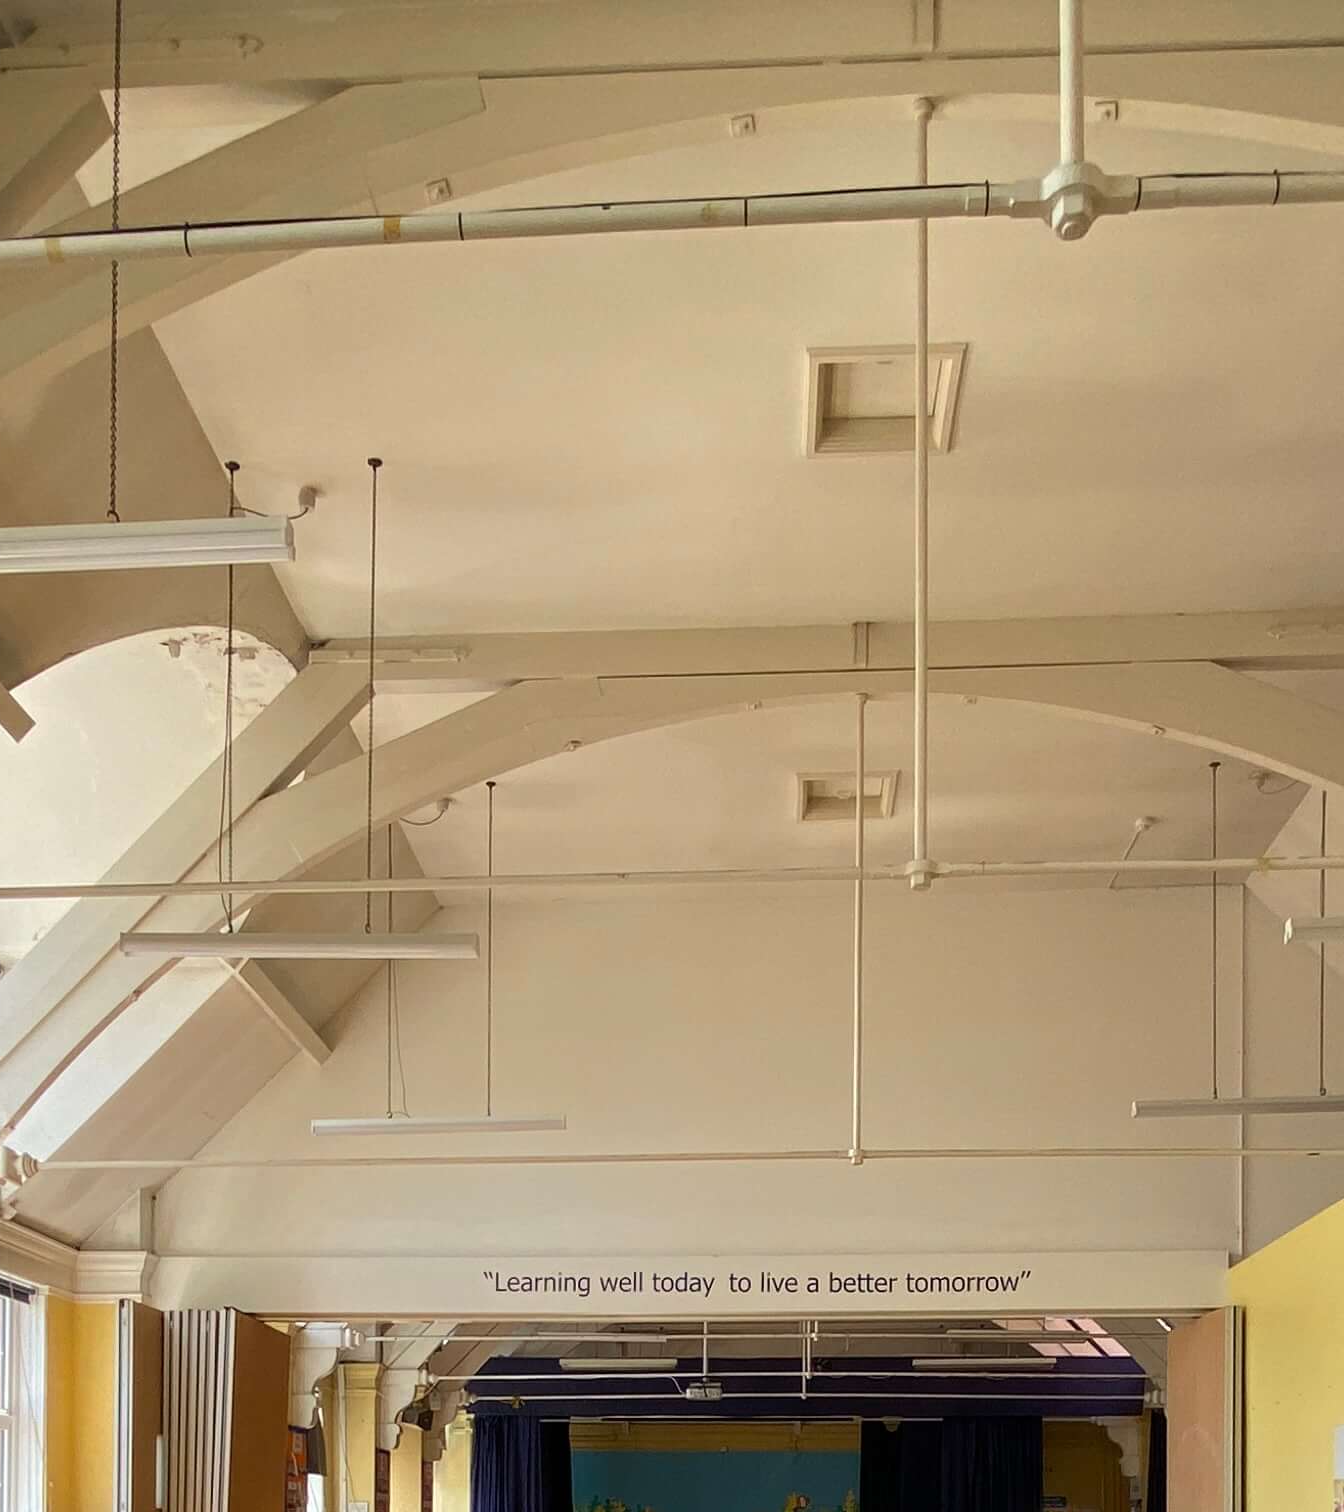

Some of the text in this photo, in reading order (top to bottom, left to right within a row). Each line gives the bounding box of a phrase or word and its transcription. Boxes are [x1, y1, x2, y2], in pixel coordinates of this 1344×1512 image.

[600, 1272, 643, 1293] well
[652, 1272, 715, 1298] today
[729, 1273, 752, 1293] to
[760, 1271, 799, 1293] live
[806, 1276, 819, 1293] a
[829, 1272, 898, 1293] better
